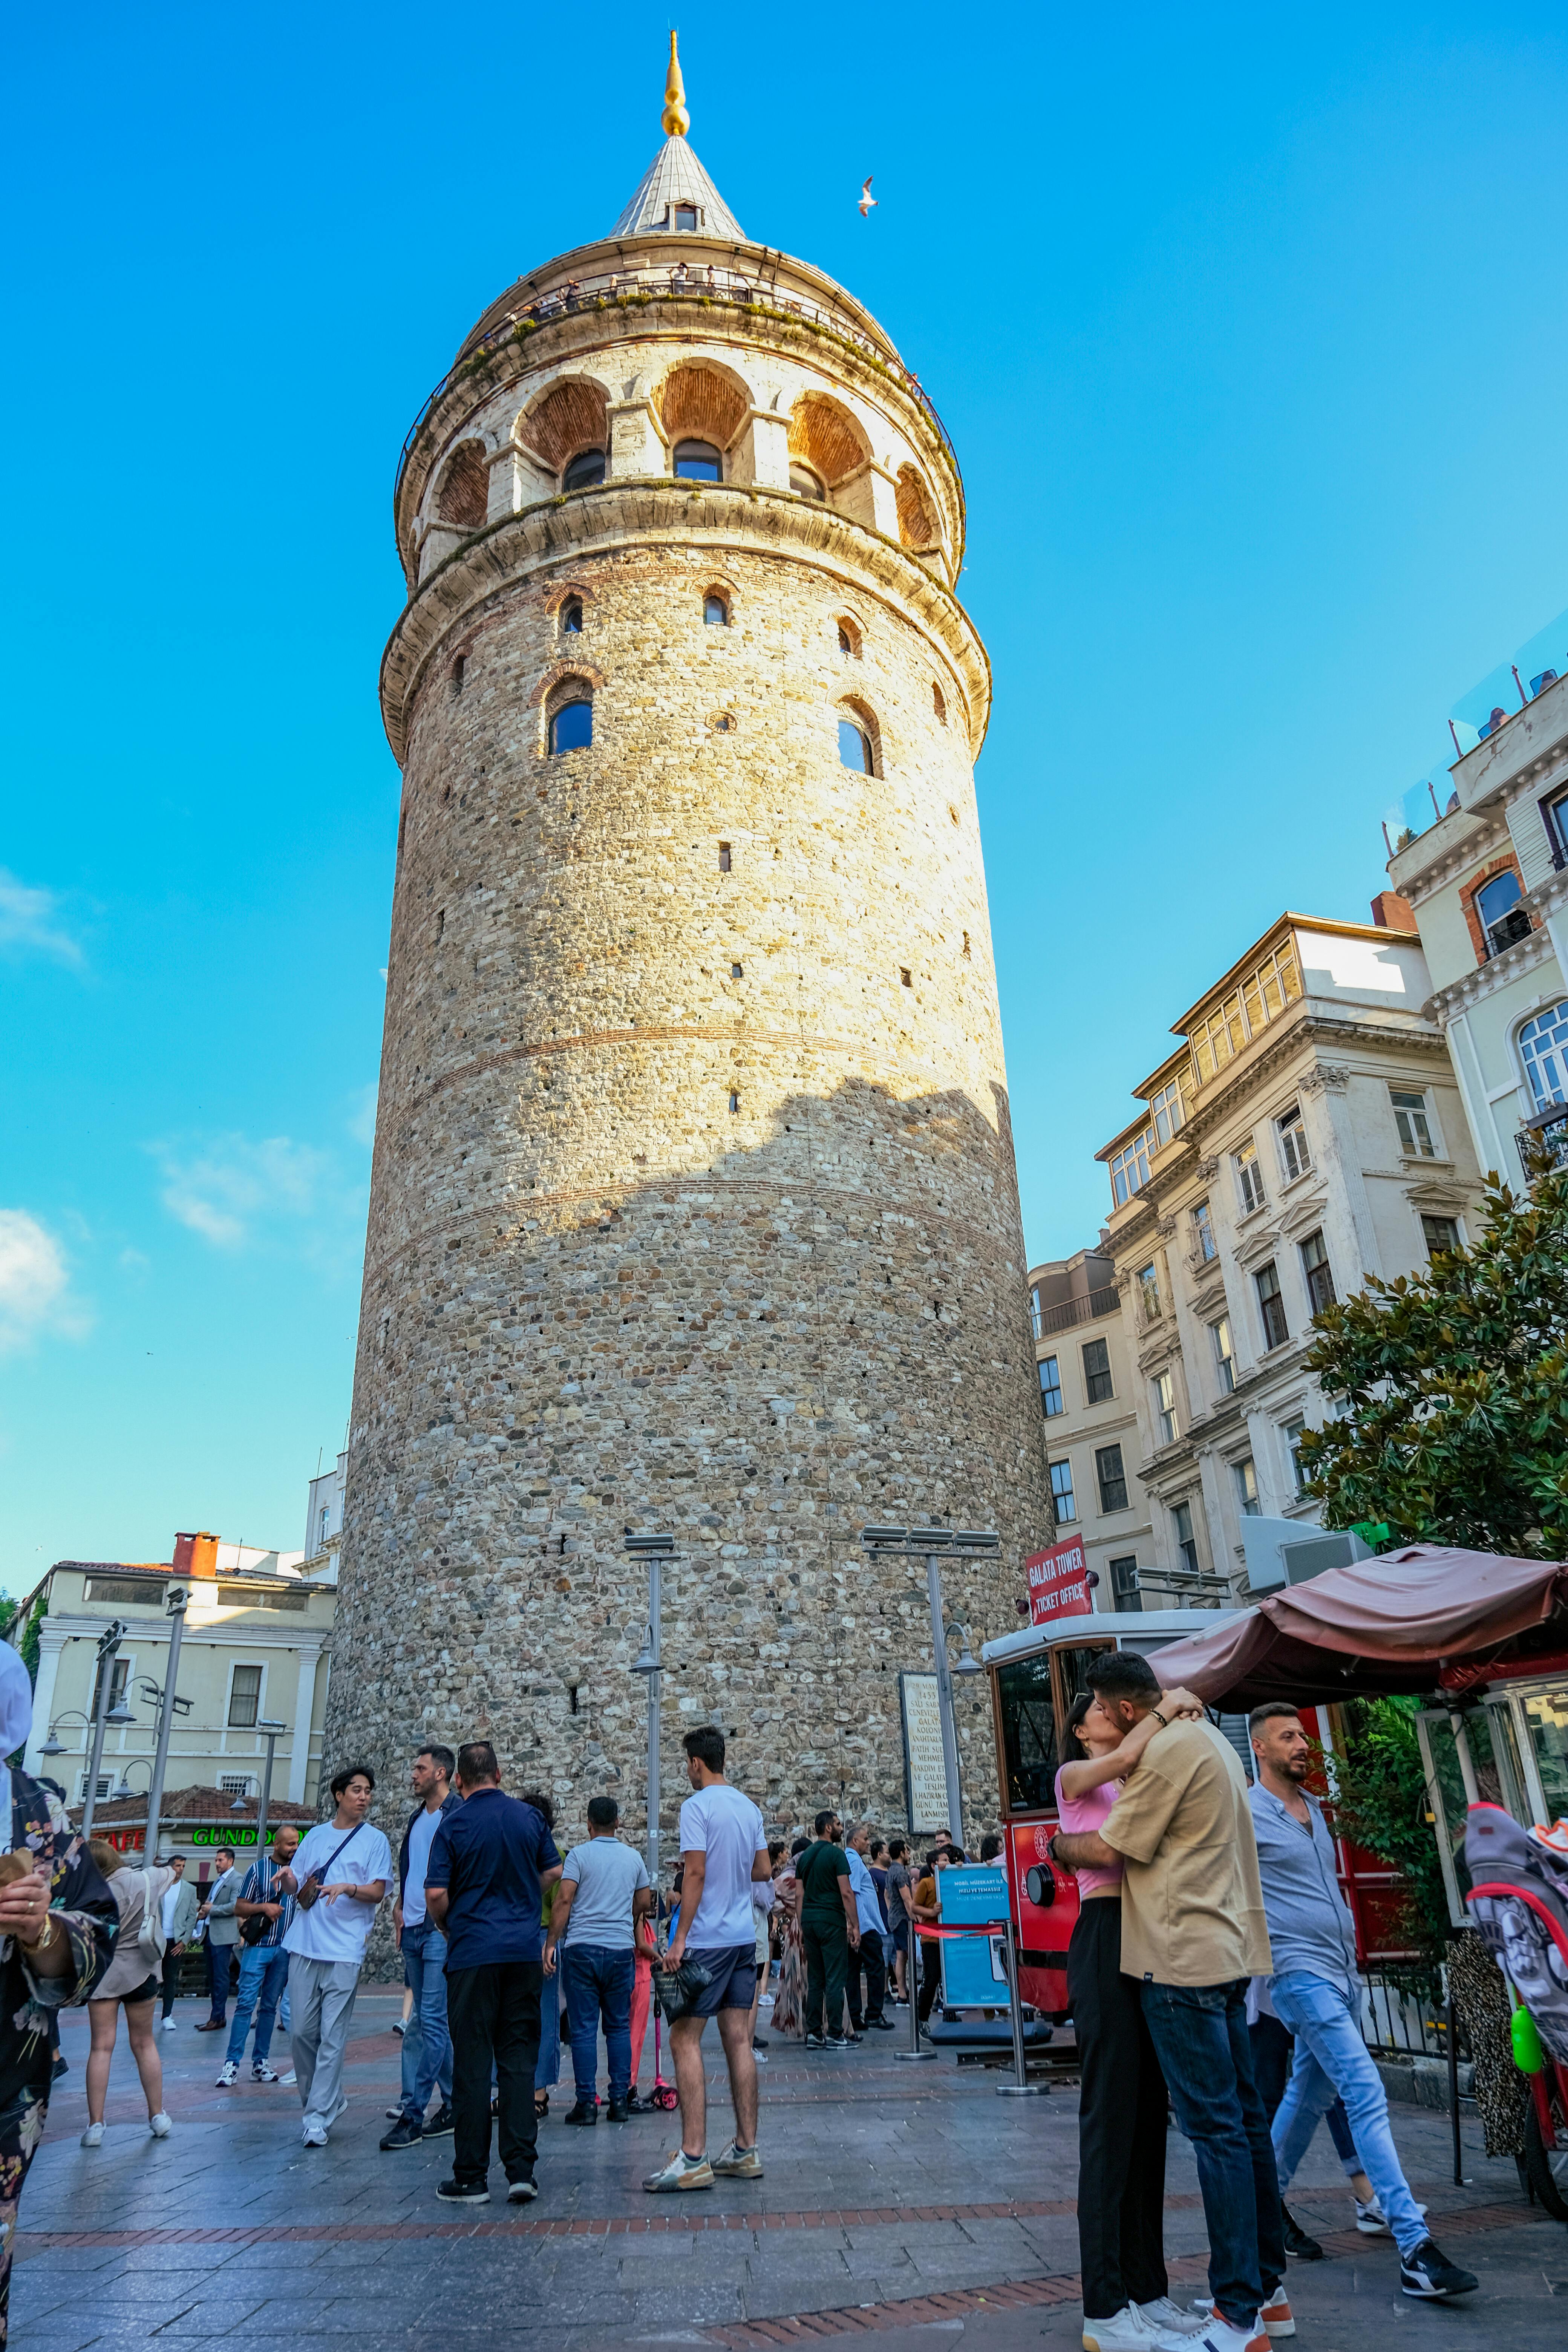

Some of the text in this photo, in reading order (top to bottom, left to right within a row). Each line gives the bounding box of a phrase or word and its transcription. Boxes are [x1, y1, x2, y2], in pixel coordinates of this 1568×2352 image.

[1029, 1547, 1083, 1587] GALATA TOWER
[1036, 1582, 1083, 1614] TICKET OFFICE
[920, 1691, 936, 1700] 1453
[916, 1800, 933, 1808] GÜNÜ
[193, 1827, 309, 1845] GÜNDO
